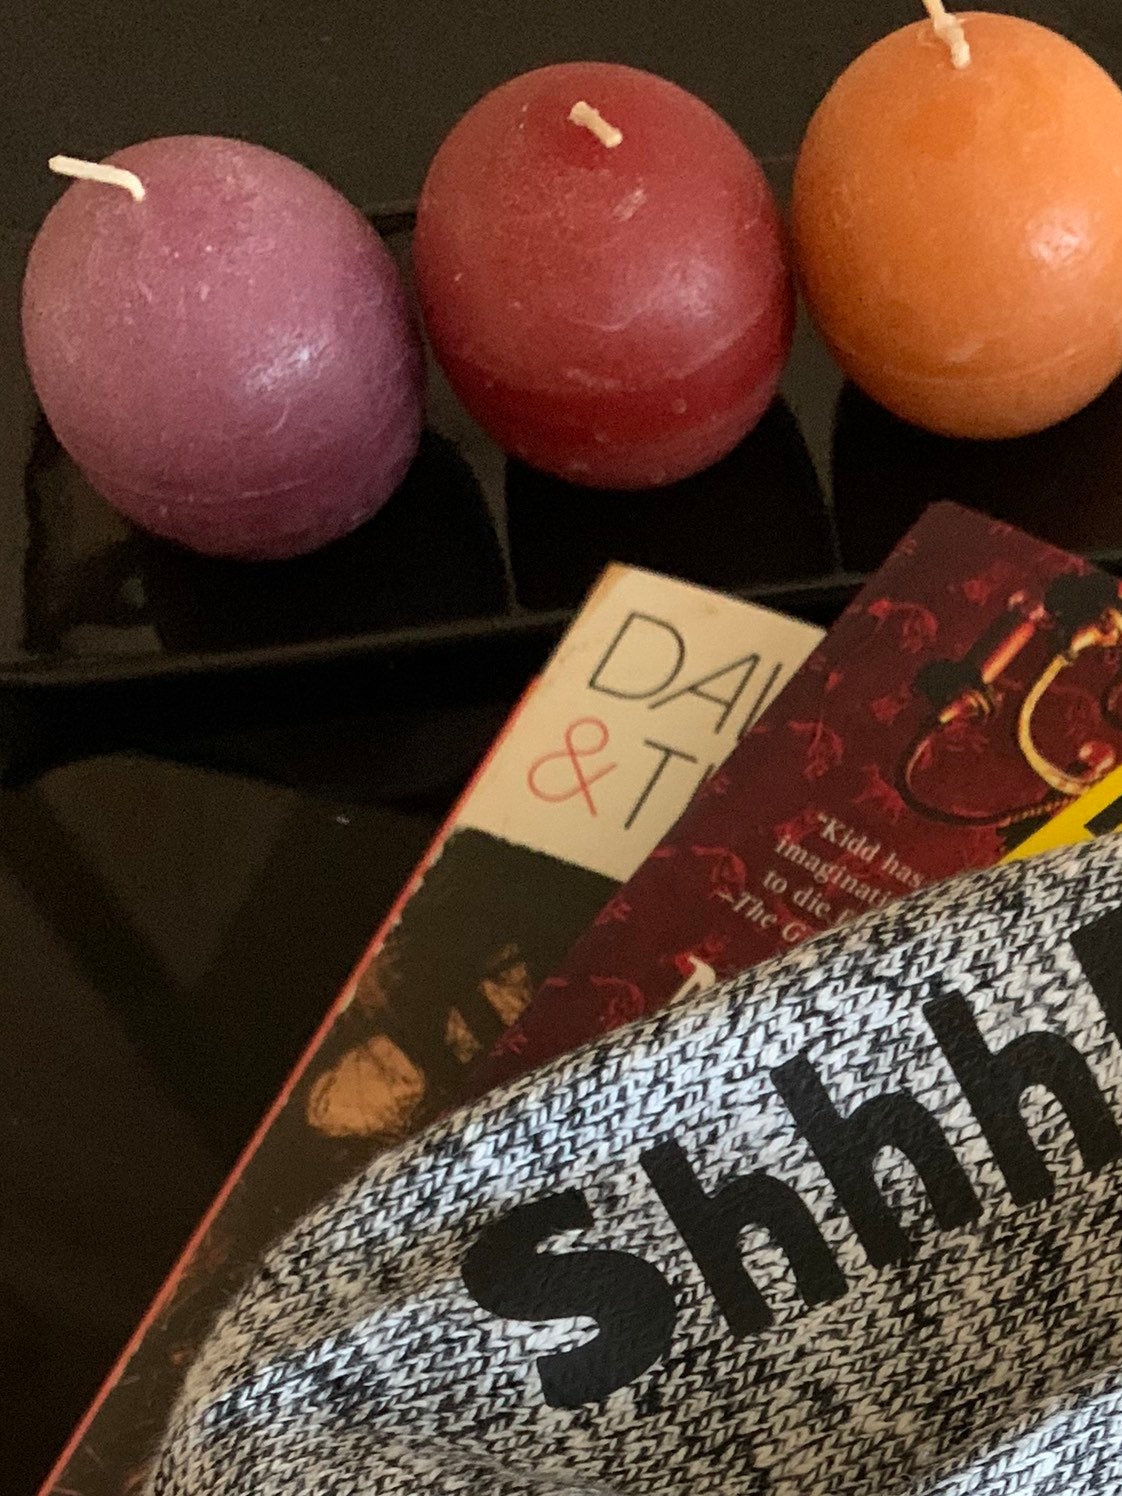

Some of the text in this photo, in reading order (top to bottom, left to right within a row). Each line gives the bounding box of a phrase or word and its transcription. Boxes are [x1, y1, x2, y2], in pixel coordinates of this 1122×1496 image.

[527, 717, 617, 817] &
[881, 852, 924, 889] has
[762, 871, 788, 894] to
[793, 887, 831, 919] die
